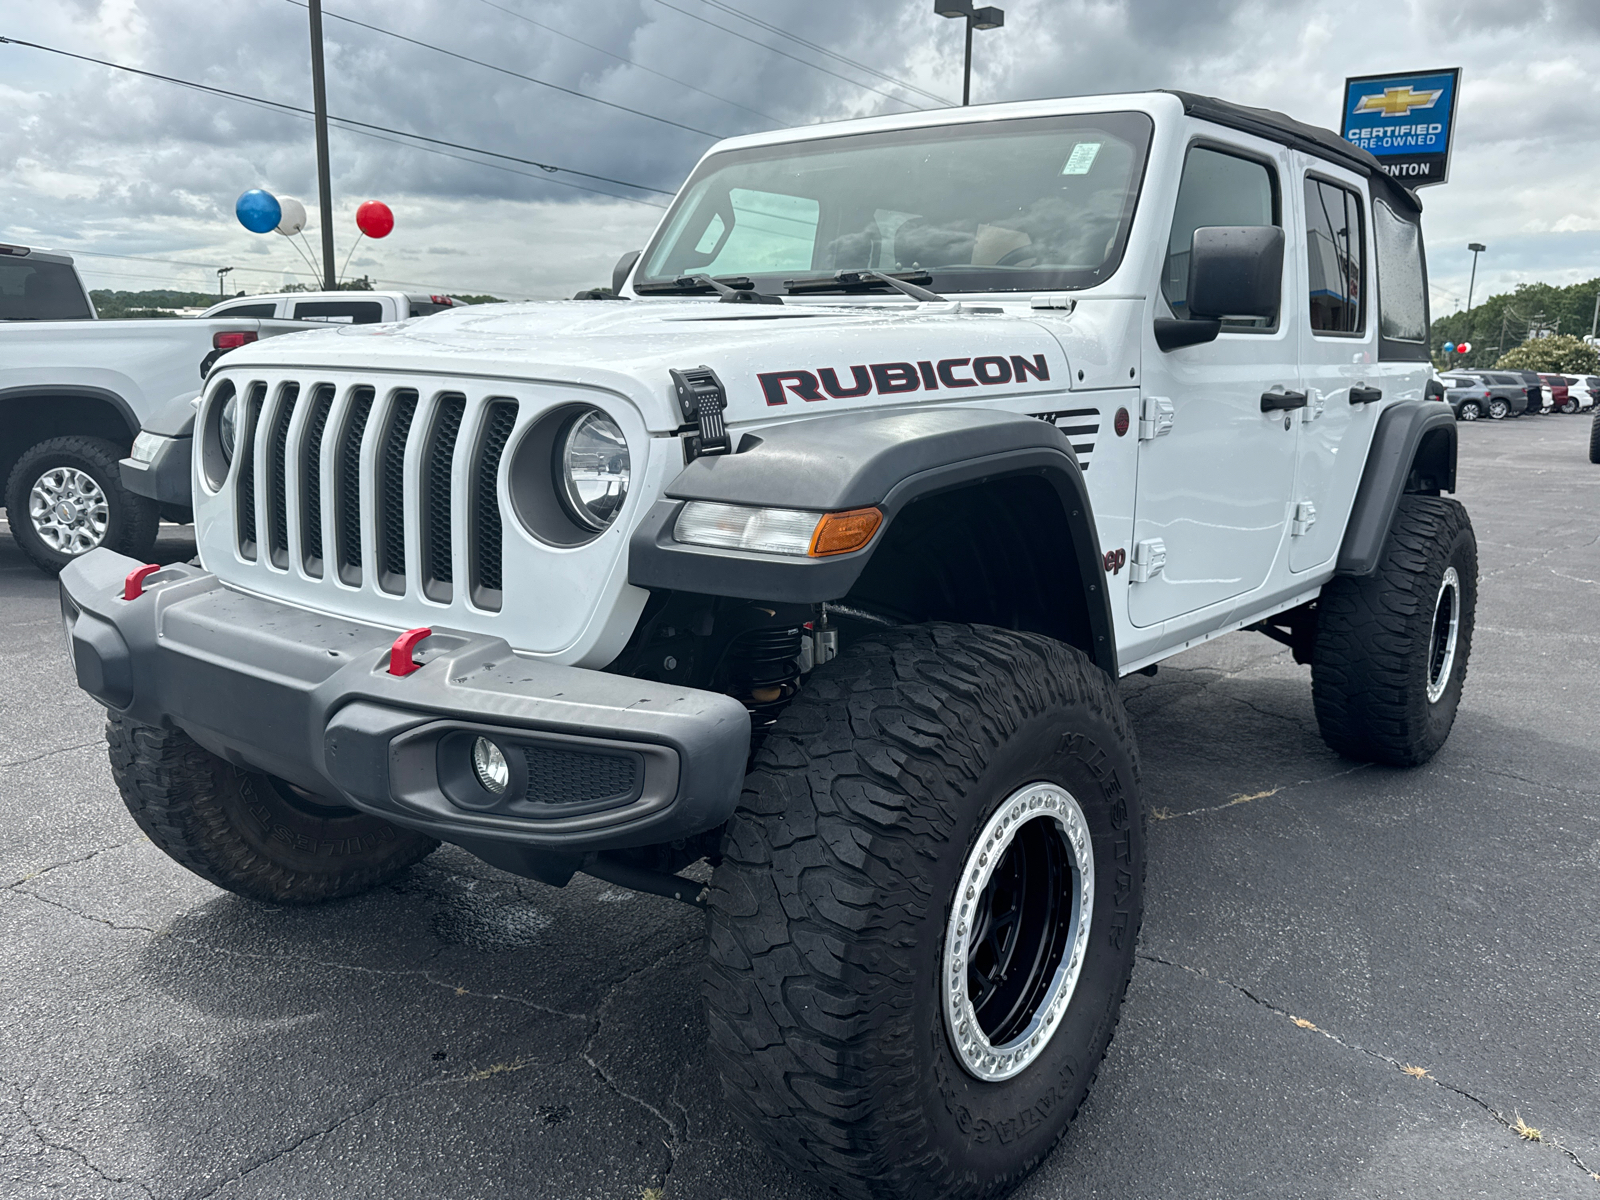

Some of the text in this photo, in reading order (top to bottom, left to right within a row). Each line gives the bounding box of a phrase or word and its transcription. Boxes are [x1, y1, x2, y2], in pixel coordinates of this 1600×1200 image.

[1348, 123, 1442, 139] CERTIFIED
[757, 353, 1050, 406] RUBICON
[1102, 547, 1126, 575] ep
[1055, 731, 1133, 951] MILESTAR
